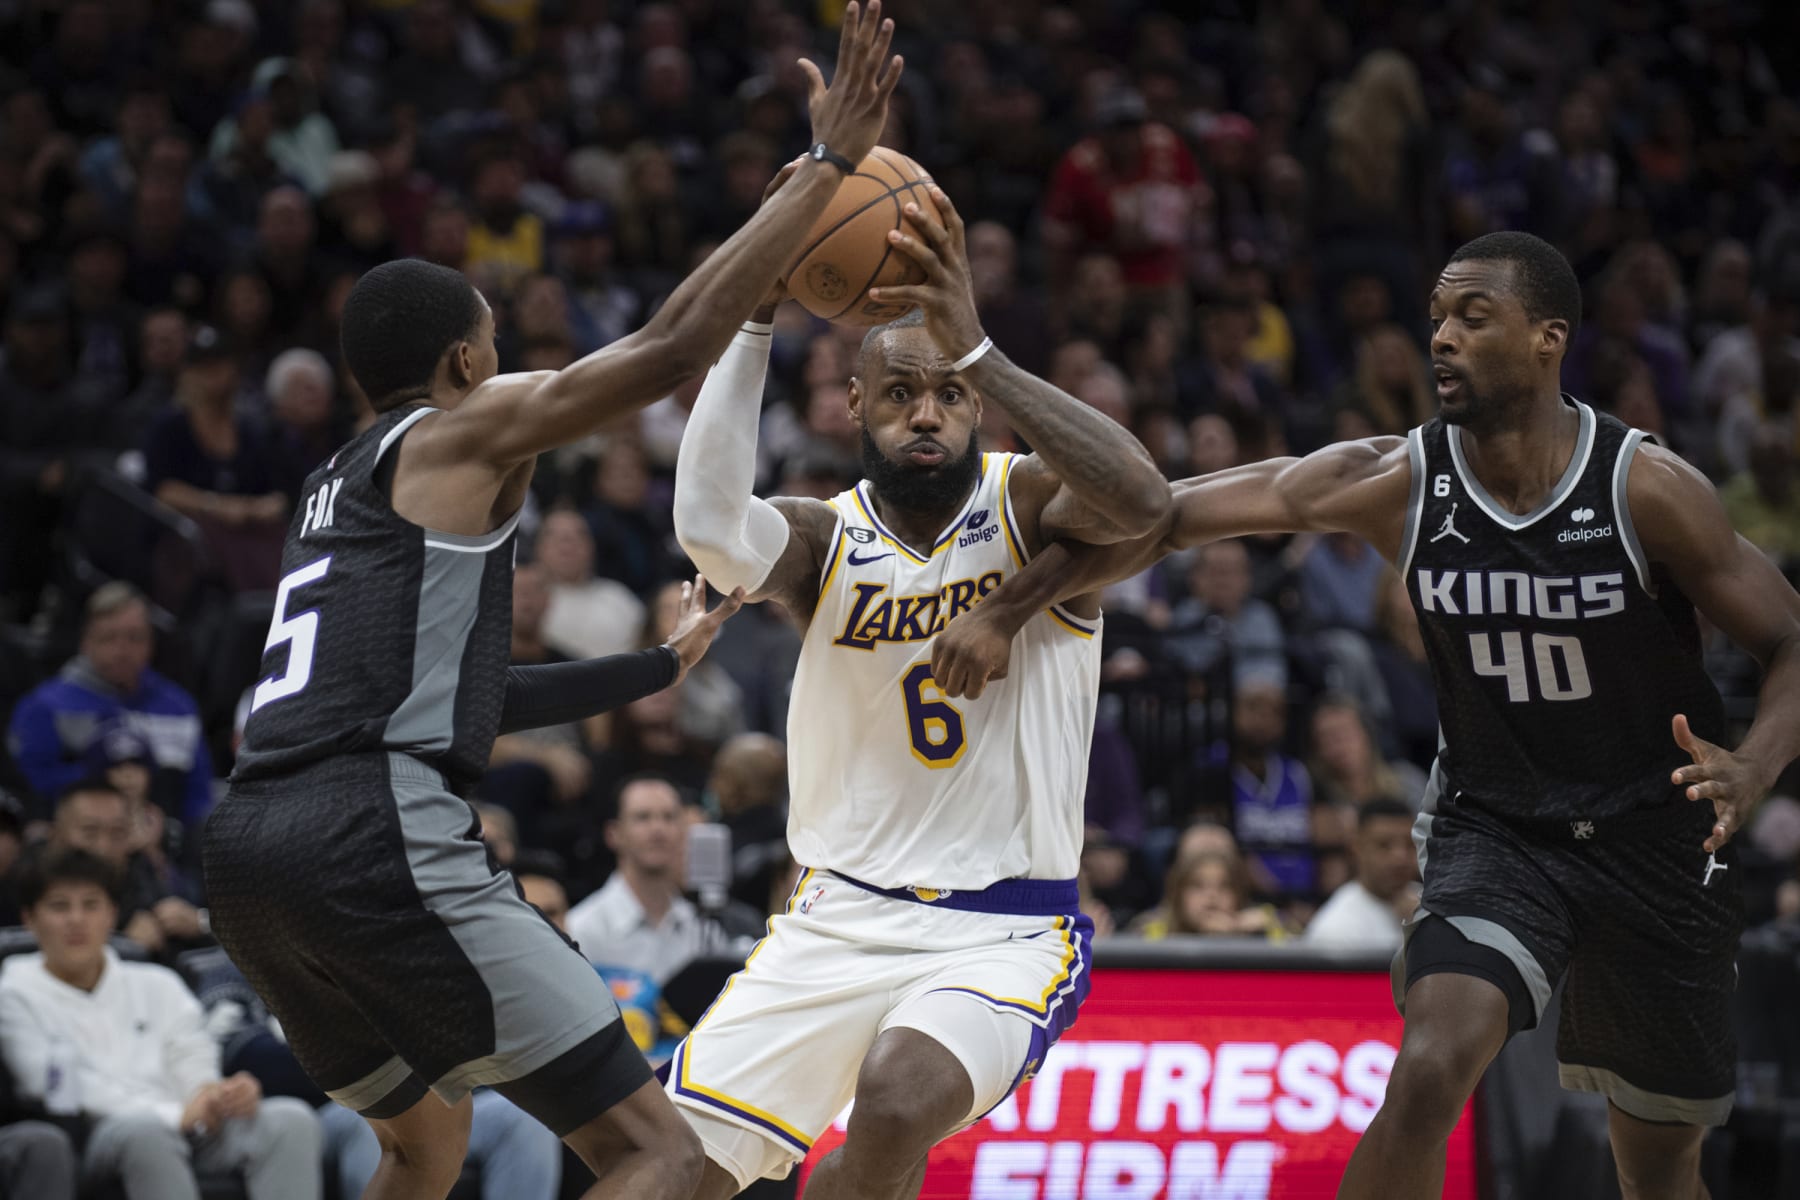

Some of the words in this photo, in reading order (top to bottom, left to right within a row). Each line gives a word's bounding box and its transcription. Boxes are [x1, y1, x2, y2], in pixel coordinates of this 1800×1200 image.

[300, 477, 344, 539] FOX
[1434, 474, 1451, 497] 6
[959, 524, 1000, 548] bibigo
[1557, 523, 1612, 542] dialpad
[1417, 569, 1625, 619] KINGS
[250, 555, 332, 714] 5
[1468, 631, 1592, 702] 40
[901, 661, 968, 769] 6
[832, 1039, 1399, 1133] TTRESS
